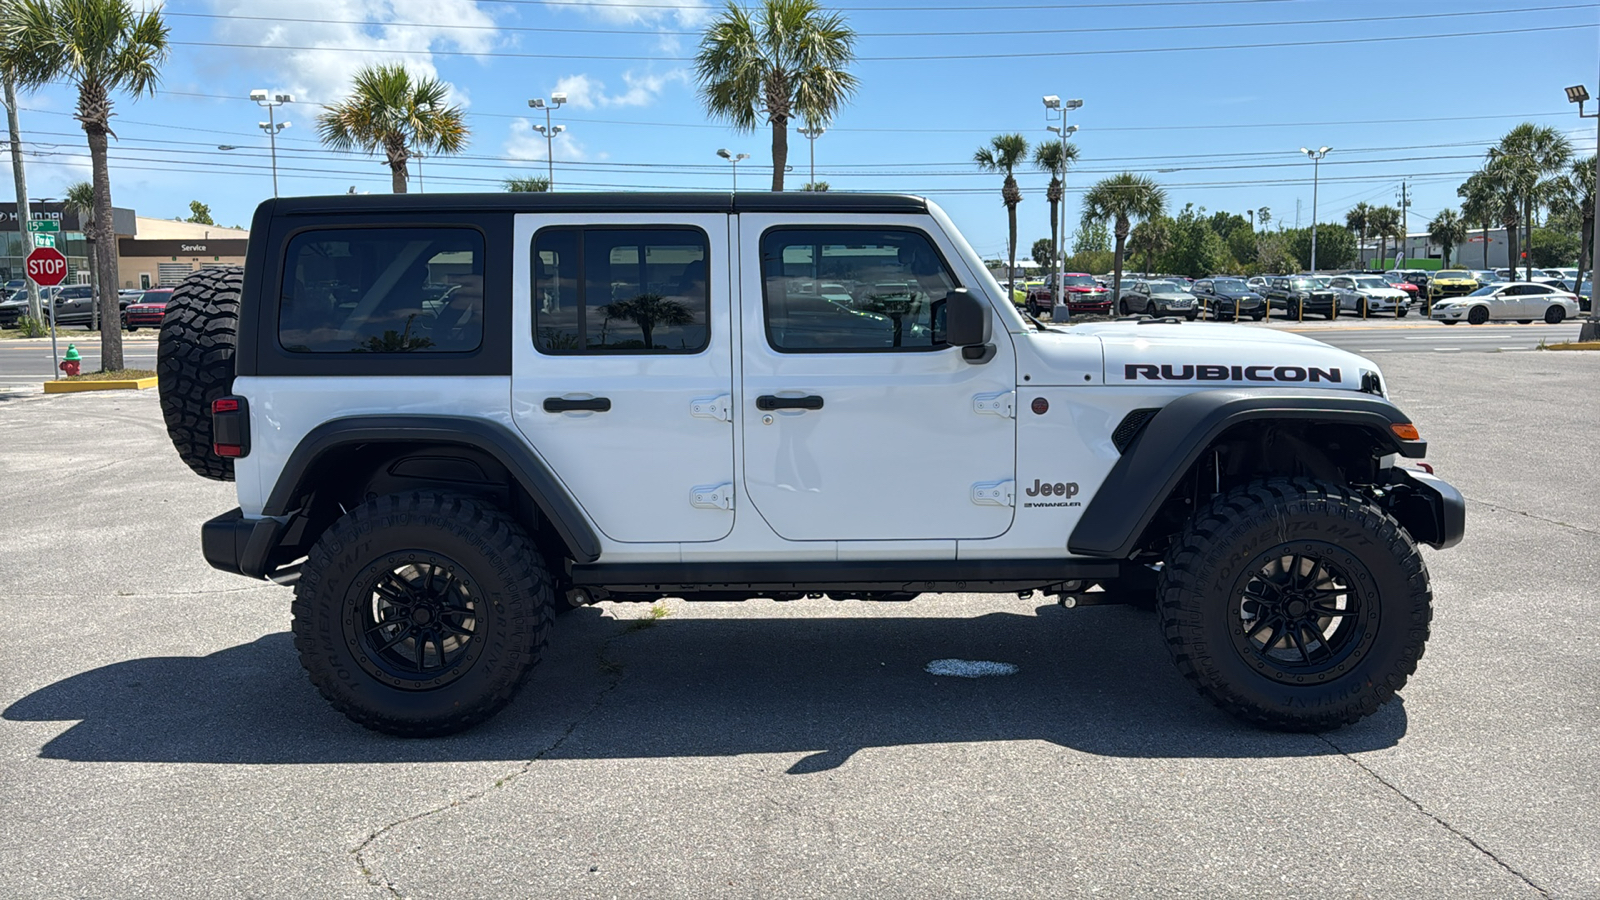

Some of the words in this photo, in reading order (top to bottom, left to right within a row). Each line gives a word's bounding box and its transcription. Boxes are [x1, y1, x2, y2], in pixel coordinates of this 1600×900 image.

[10, 212, 64, 220] HNDAI
[181, 244, 207, 252] Service
[29, 259, 64, 275] STOP
[1125, 363, 1342, 383] RUBICON
[1025, 479, 1080, 499] Jeep
[1213, 519, 1320, 593] TORMENTA
[1327, 522, 1375, 548] M/T
